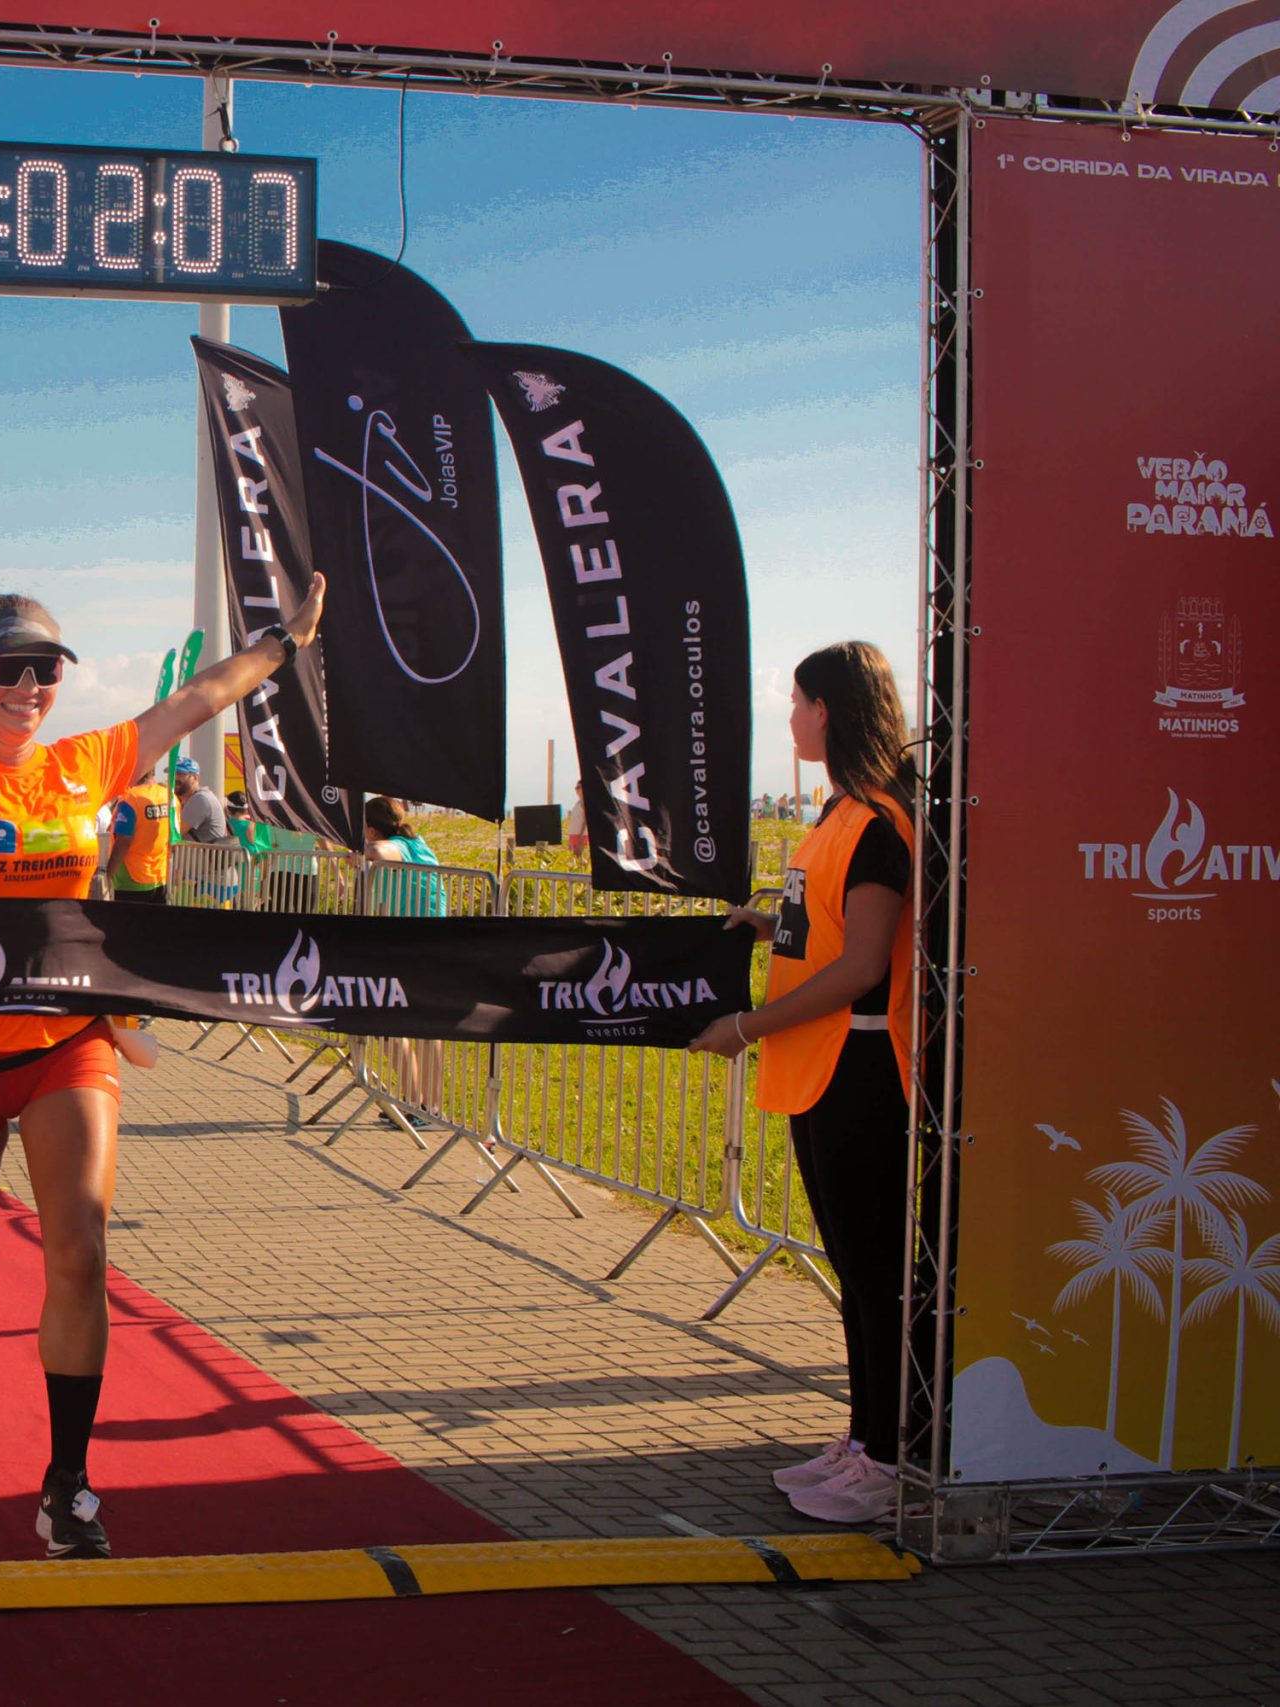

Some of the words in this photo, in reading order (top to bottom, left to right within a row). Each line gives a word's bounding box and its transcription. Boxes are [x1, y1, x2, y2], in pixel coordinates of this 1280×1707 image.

[1023, 156, 1129, 177] CORRIDA
[1137, 163, 1172, 181] DA
[1180, 167, 1269, 187] VIRADA
[1136, 450, 1228, 480] VERÃO
[1155, 480, 1246, 507] MAIOR
[1126, 501, 1274, 538] PARANÁ
[540, 419, 659, 873] CAVALERA
[1180, 692, 1223, 700] MATINHOS
[683, 599, 717, 863] @cavalera.oculos
[1158, 718, 1239, 733] MATINHOS
[1078, 842, 1141, 881] TRI
[1147, 904, 1202, 923] sports
[222, 972, 274, 1004] TRI
[323, 976, 409, 1008] ATIVA
[538, 980, 585, 1010] TRI
[629, 978, 719, 1009] ATIVA
[586, 1025, 646, 1038] eventos
